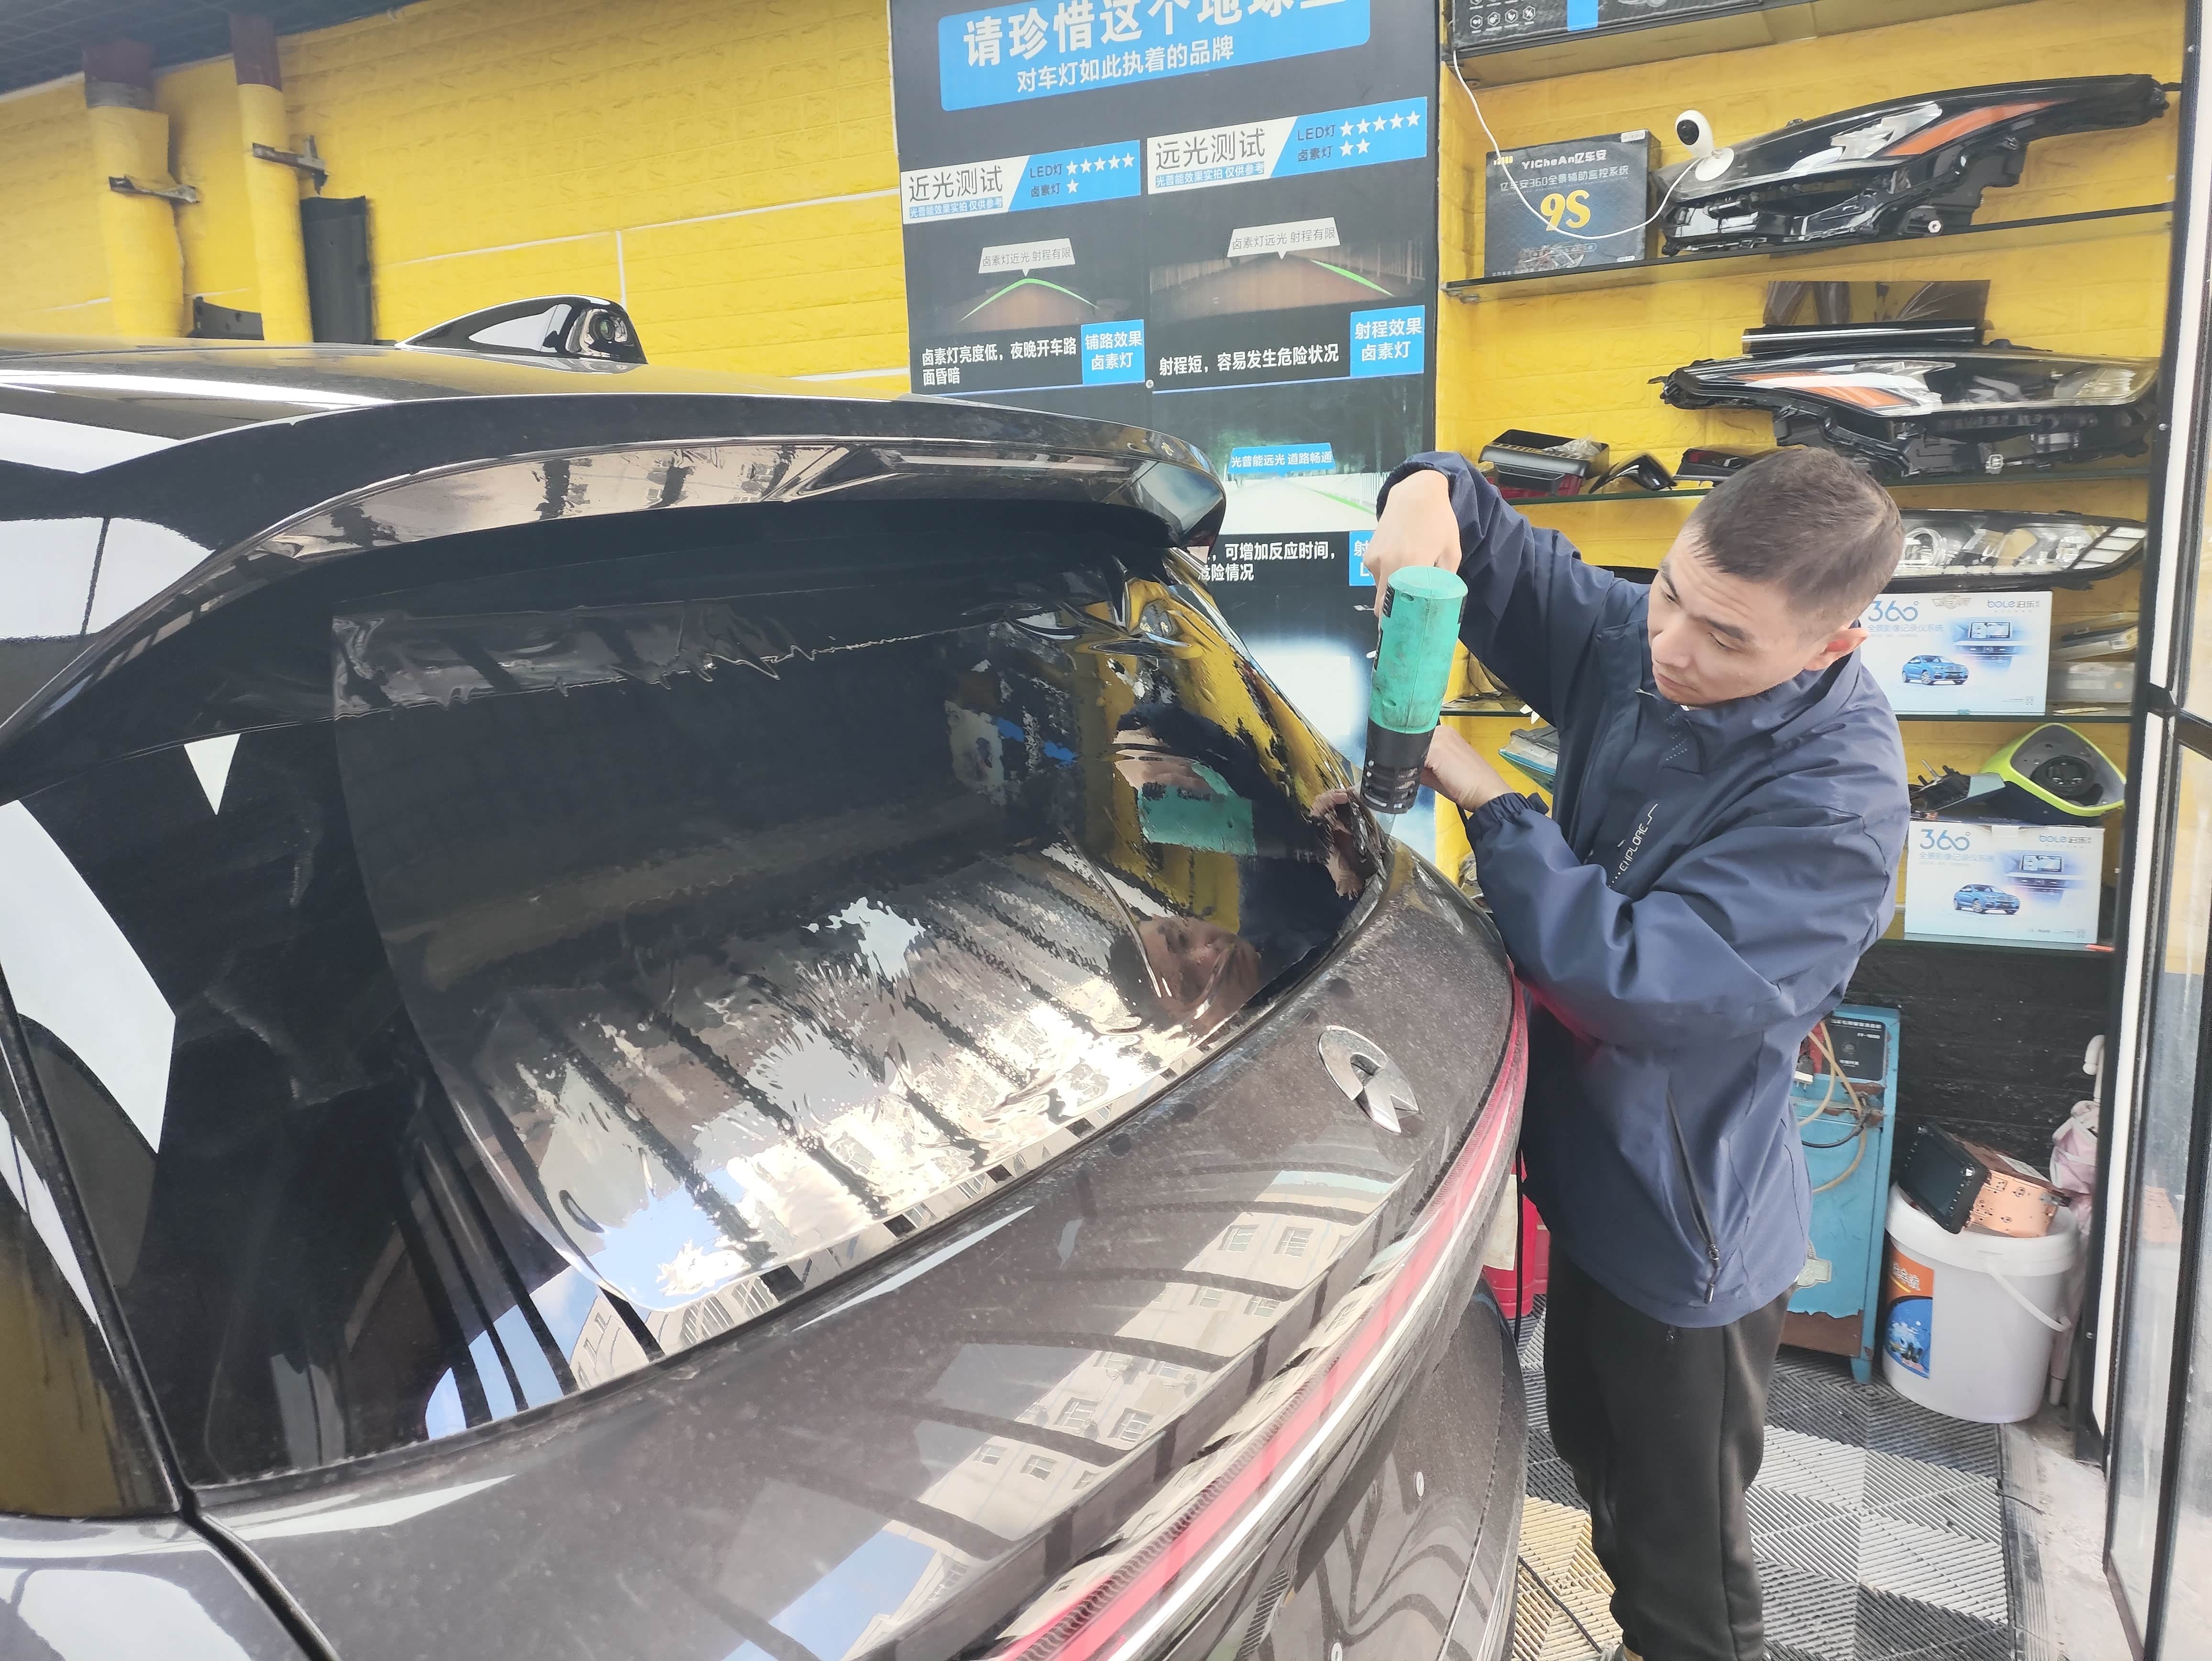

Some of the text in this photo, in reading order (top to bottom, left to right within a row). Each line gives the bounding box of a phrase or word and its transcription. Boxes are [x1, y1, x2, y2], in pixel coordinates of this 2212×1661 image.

[1017, 34, 1234, 93] 对车灯如此执着的品牌
[1297, 124, 1336, 141] LED灯
[1156, 127, 1265, 171] 远光测试
[1298, 146, 1333, 162] 卤素灯
[1030, 163, 1063, 178] LED灯
[909, 165, 1003, 202] 近光测试
[1030, 183, 1060, 198] 卤素灯
[1540, 189, 1591, 231] 9S
[1232, 227, 1336, 250] 卤素灯远光 射程有限
[983, 247, 1071, 266] 卤素灯近光 射程有限
[1355, 317, 1423, 340] 射程效果
[1085, 330, 1142, 350] 铺路效果
[1091, 352, 1133, 371] 卤素灯
[1361, 341, 1411, 362] 卤素灯
[923, 366, 960, 386] 面昏暗
[1231, 451, 1332, 468] 光普能远光 道路畅通
[1208, 541, 1335, 561] ，可增加反应时间，
[1619, 822, 1649, 871] EXPLORE
